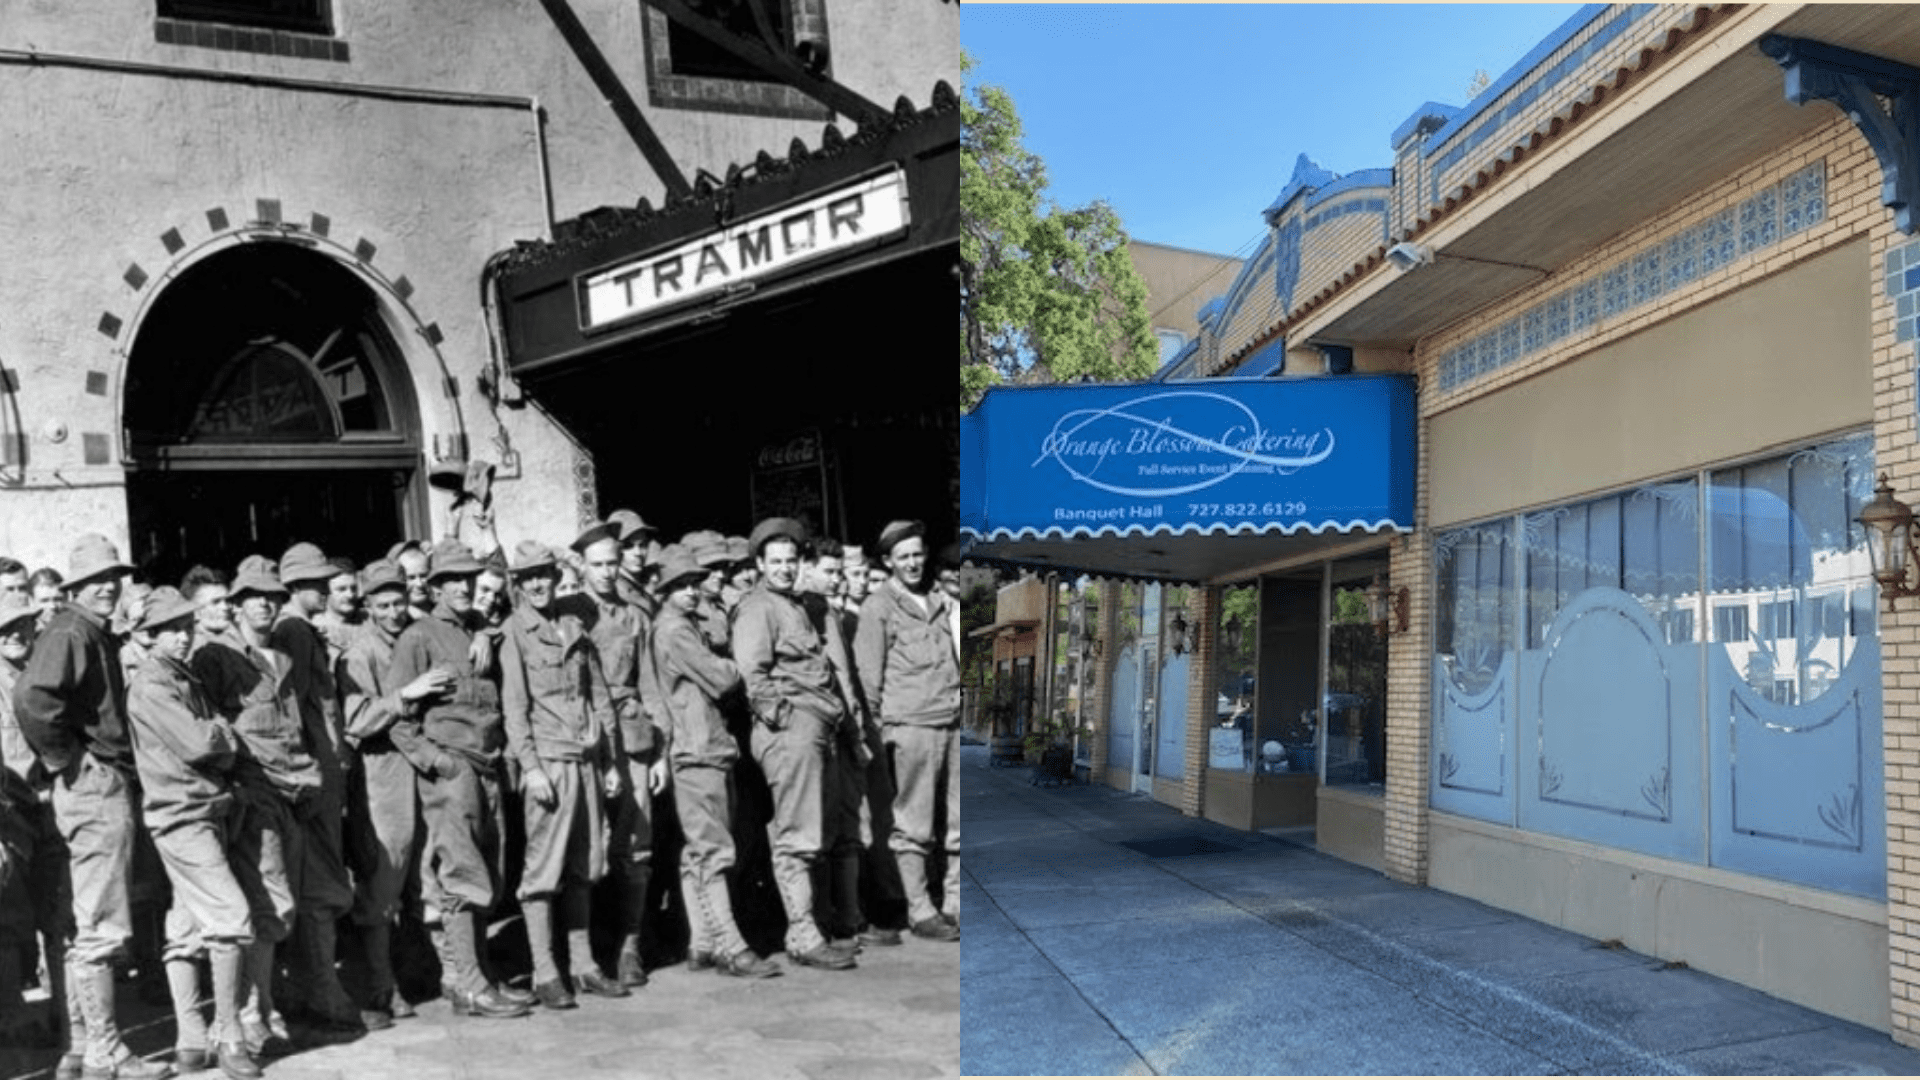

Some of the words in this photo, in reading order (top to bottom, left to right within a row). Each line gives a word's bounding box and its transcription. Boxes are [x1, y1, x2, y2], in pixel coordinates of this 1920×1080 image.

[613, 194, 865, 308] TRAMOR
[1041, 431, 1121, 477] Orange
[1126, 416, 1213, 453] Blossom
[1221, 425, 1321, 470] Catering
[1054, 506, 1125, 522] Banquet
[1129, 505, 1163, 519] Hall
[1188, 502, 1307, 517] 727.822.6129
